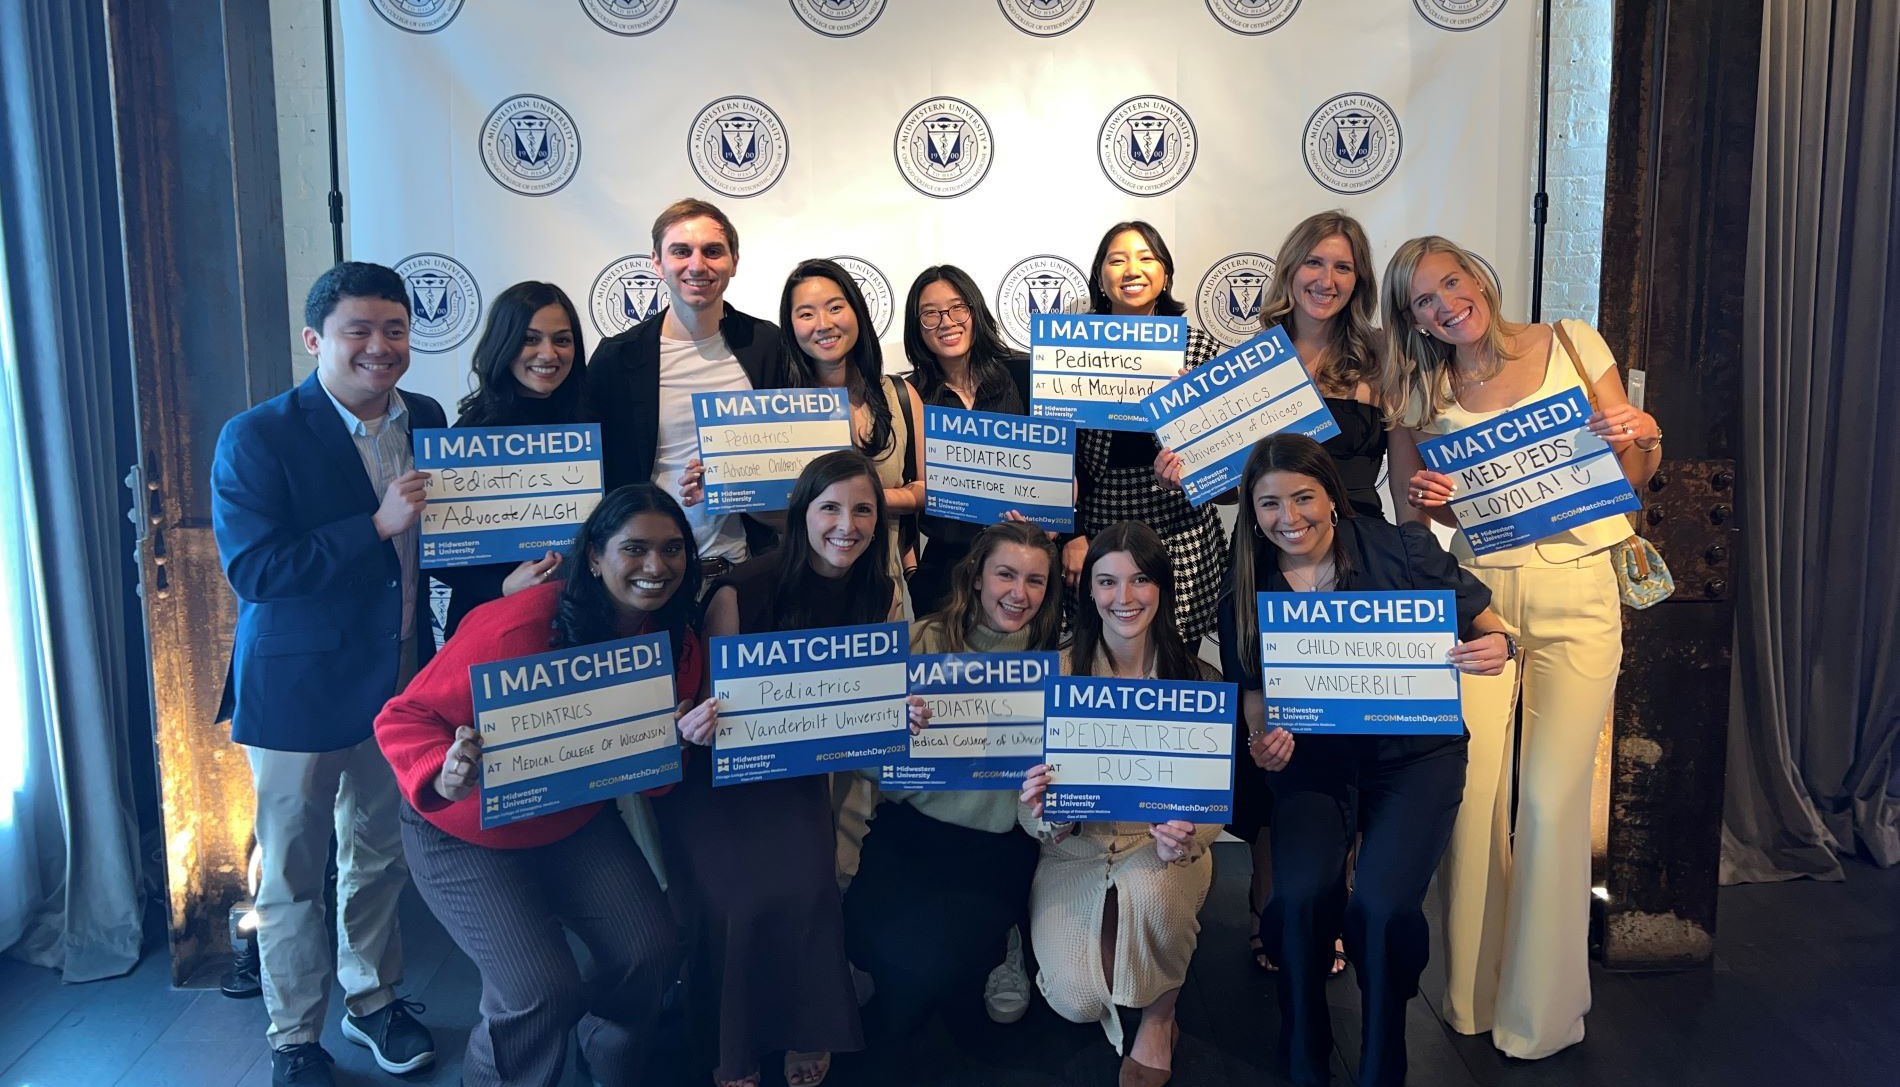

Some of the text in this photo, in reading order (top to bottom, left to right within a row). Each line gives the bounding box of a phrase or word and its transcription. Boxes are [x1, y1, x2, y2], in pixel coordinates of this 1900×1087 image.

[488, 100, 574, 140] MIDWESTERN UNIVERSITY
[696, 102, 782, 141] MIDWESTERN UNIVERSITY
[902, 103, 987, 142] MIDWESTERN UNIVERSITY
[1106, 102, 1190, 141] MIDWESTERN UNIVERSITY
[1311, 99, 1395, 139] MIDWESTERN UNIVERSITY
[400, 259, 475, 298] ESTERN UNIVERSITY
[597, 261, 641, 298] MIDWESTERN
[850, 263, 887, 299] UNIVERSITY
[1004, 261, 1087, 298] MIDWESTERN UNIVERSITY
[1204, 259, 1248, 297] MIDWESTERN
[1039, 320, 1178, 343] I MATCHED!
[1056, 349, 1142, 370] Pediatrics
[1071, 377, 1082, 396] of
[1089, 379, 1154, 404] Maryland
[1149, 336, 1284, 420] I MATCHED!
[702, 394, 841, 418] I MATCHED!
[1108, 414, 1149, 423] #CCOMMatc
[1162, 434, 1171, 443] IN
[1175, 386, 1270, 442] Pediatrics
[931, 413, 1067, 445] I MATCHED!
[1186, 429, 1244, 464] University
[1249, 423, 1257, 432] of
[1260, 401, 1303, 426] Chicago
[1428, 398, 1582, 468] I MATCHED!
[424, 431, 592, 460] I MATCHED!
[946, 445, 1032, 470] PEDIATRICS
[723, 462, 761, 478] Advocate
[1197, 466, 1228, 484] Midwestern
[1461, 438, 1573, 490] MED-PEDS
[441, 467, 553, 491] Pediatrics
[943, 476, 1005, 494] MONTEFIORE
[1199, 473, 1228, 490] University
[938, 498, 969, 507] Midwestern
[938, 503, 965, 512] University
[1459, 474, 1563, 519] AT LOYOLA!
[424, 501, 578, 530] AT Advocate/ALGH
[519, 538, 576, 549] #CCOMMatch
[1480, 525, 1514, 537] Midwestern
[1484, 532, 1513, 543] University
[439, 540, 480, 548] Midwestern
[439, 547, 475, 555] University
[1268, 599, 1445, 623] I MATCHED!
[721, 630, 898, 669] I MATCHED!
[1267, 638, 1437, 660] IN CHILD NEUROLOGY
[483, 642, 662, 699] I MATCHED!
[909, 659, 1049, 685] MATCHED!
[718, 679, 860, 704] IN Pediatrics
[1269, 675, 1416, 696] AT VANDERBILT
[1054, 684, 1226, 714] I MATCHED!
[484, 704, 593, 733] IN PEDIATRICS
[719, 707, 900, 741] AT Vanderbilt University
[1283, 713, 1319, 721] University
[1050, 720, 1218, 753] IN PEDIATRICS
[487, 763, 502, 773] AT
[512, 755, 554, 772] MEDICAL
[559, 745, 594, 762] COLLEGE
[602, 739, 614, 751] OF
[733, 753, 775, 763] Midwestern
[733, 761, 770, 771] University
[1050, 756, 1173, 783] AT RUSH
[502, 786, 548, 801] Midwestern
[502, 794, 543, 809] University
[1060, 793, 1100, 801] Midwestern
[1060, 800, 1095, 808] University
[1139, 802, 1228, 812] #CCOMMatchDay2025
